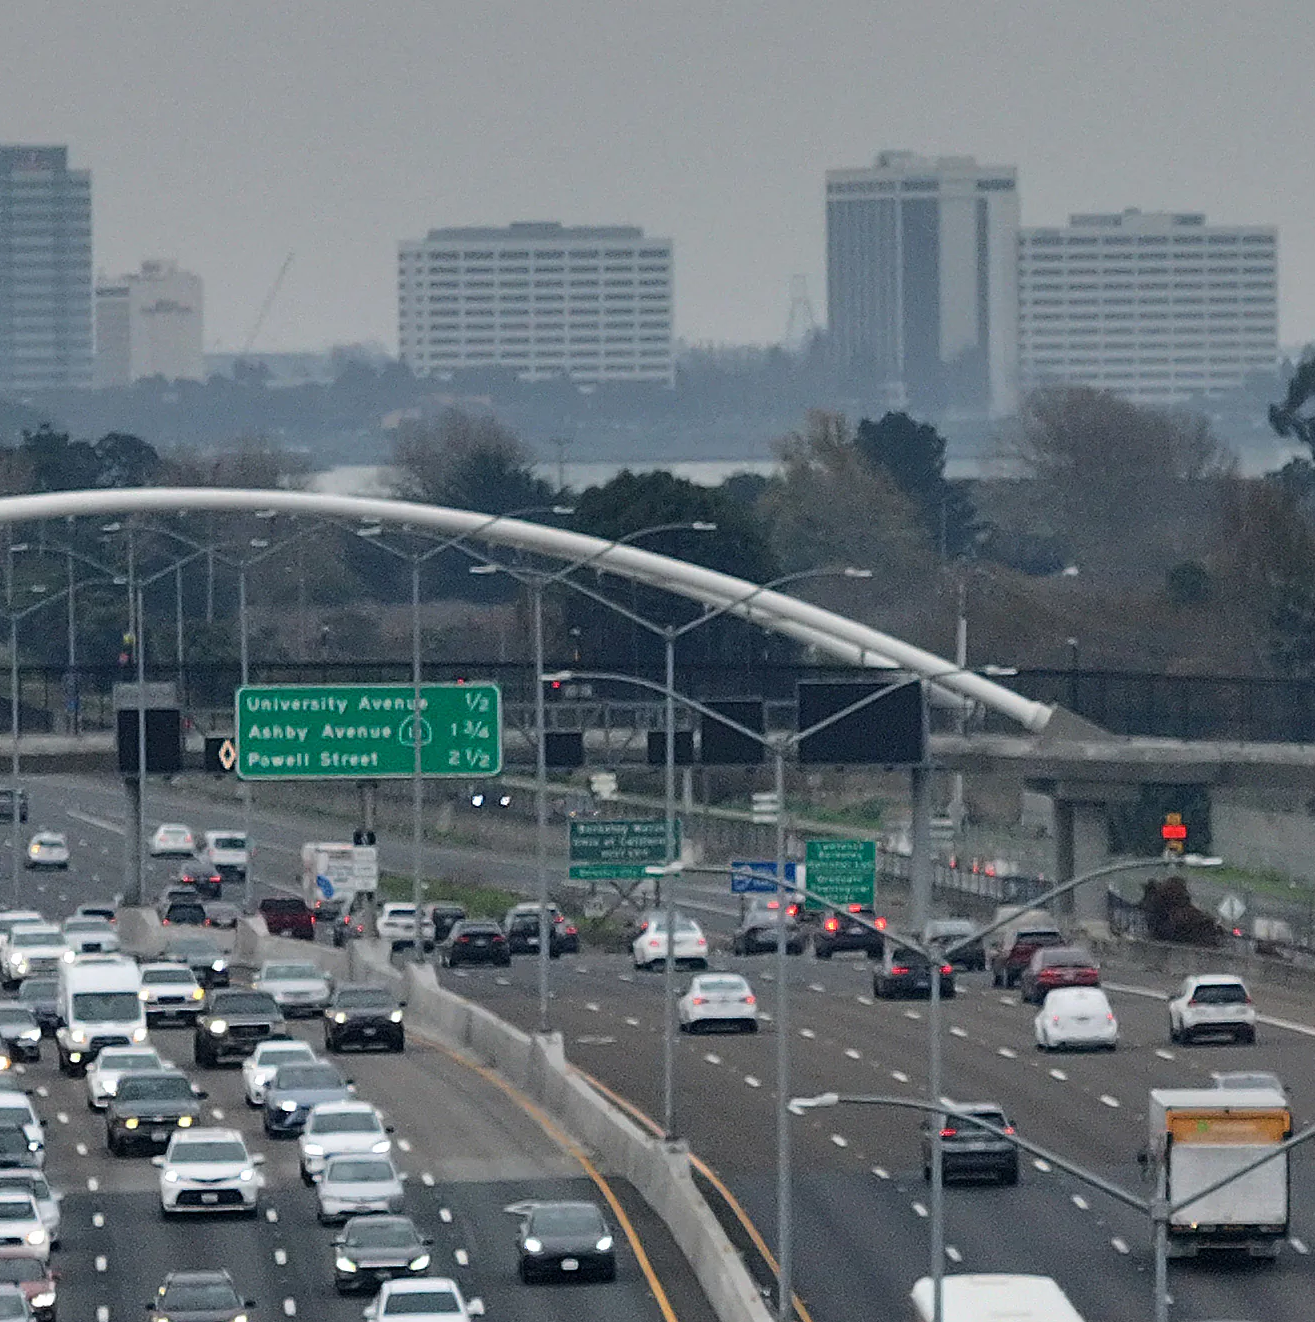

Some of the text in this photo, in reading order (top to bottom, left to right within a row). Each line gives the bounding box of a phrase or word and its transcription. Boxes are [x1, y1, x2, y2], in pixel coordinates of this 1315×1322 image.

[246, 696, 348, 714] University
[358, 696, 428, 711] Avenue
[248, 724, 309, 742] Ashby
[321, 724, 392, 739] Avenue
[247, 752, 310, 767] Powell
[319, 750, 379, 767] Street
[448, 750, 461, 766] 2
